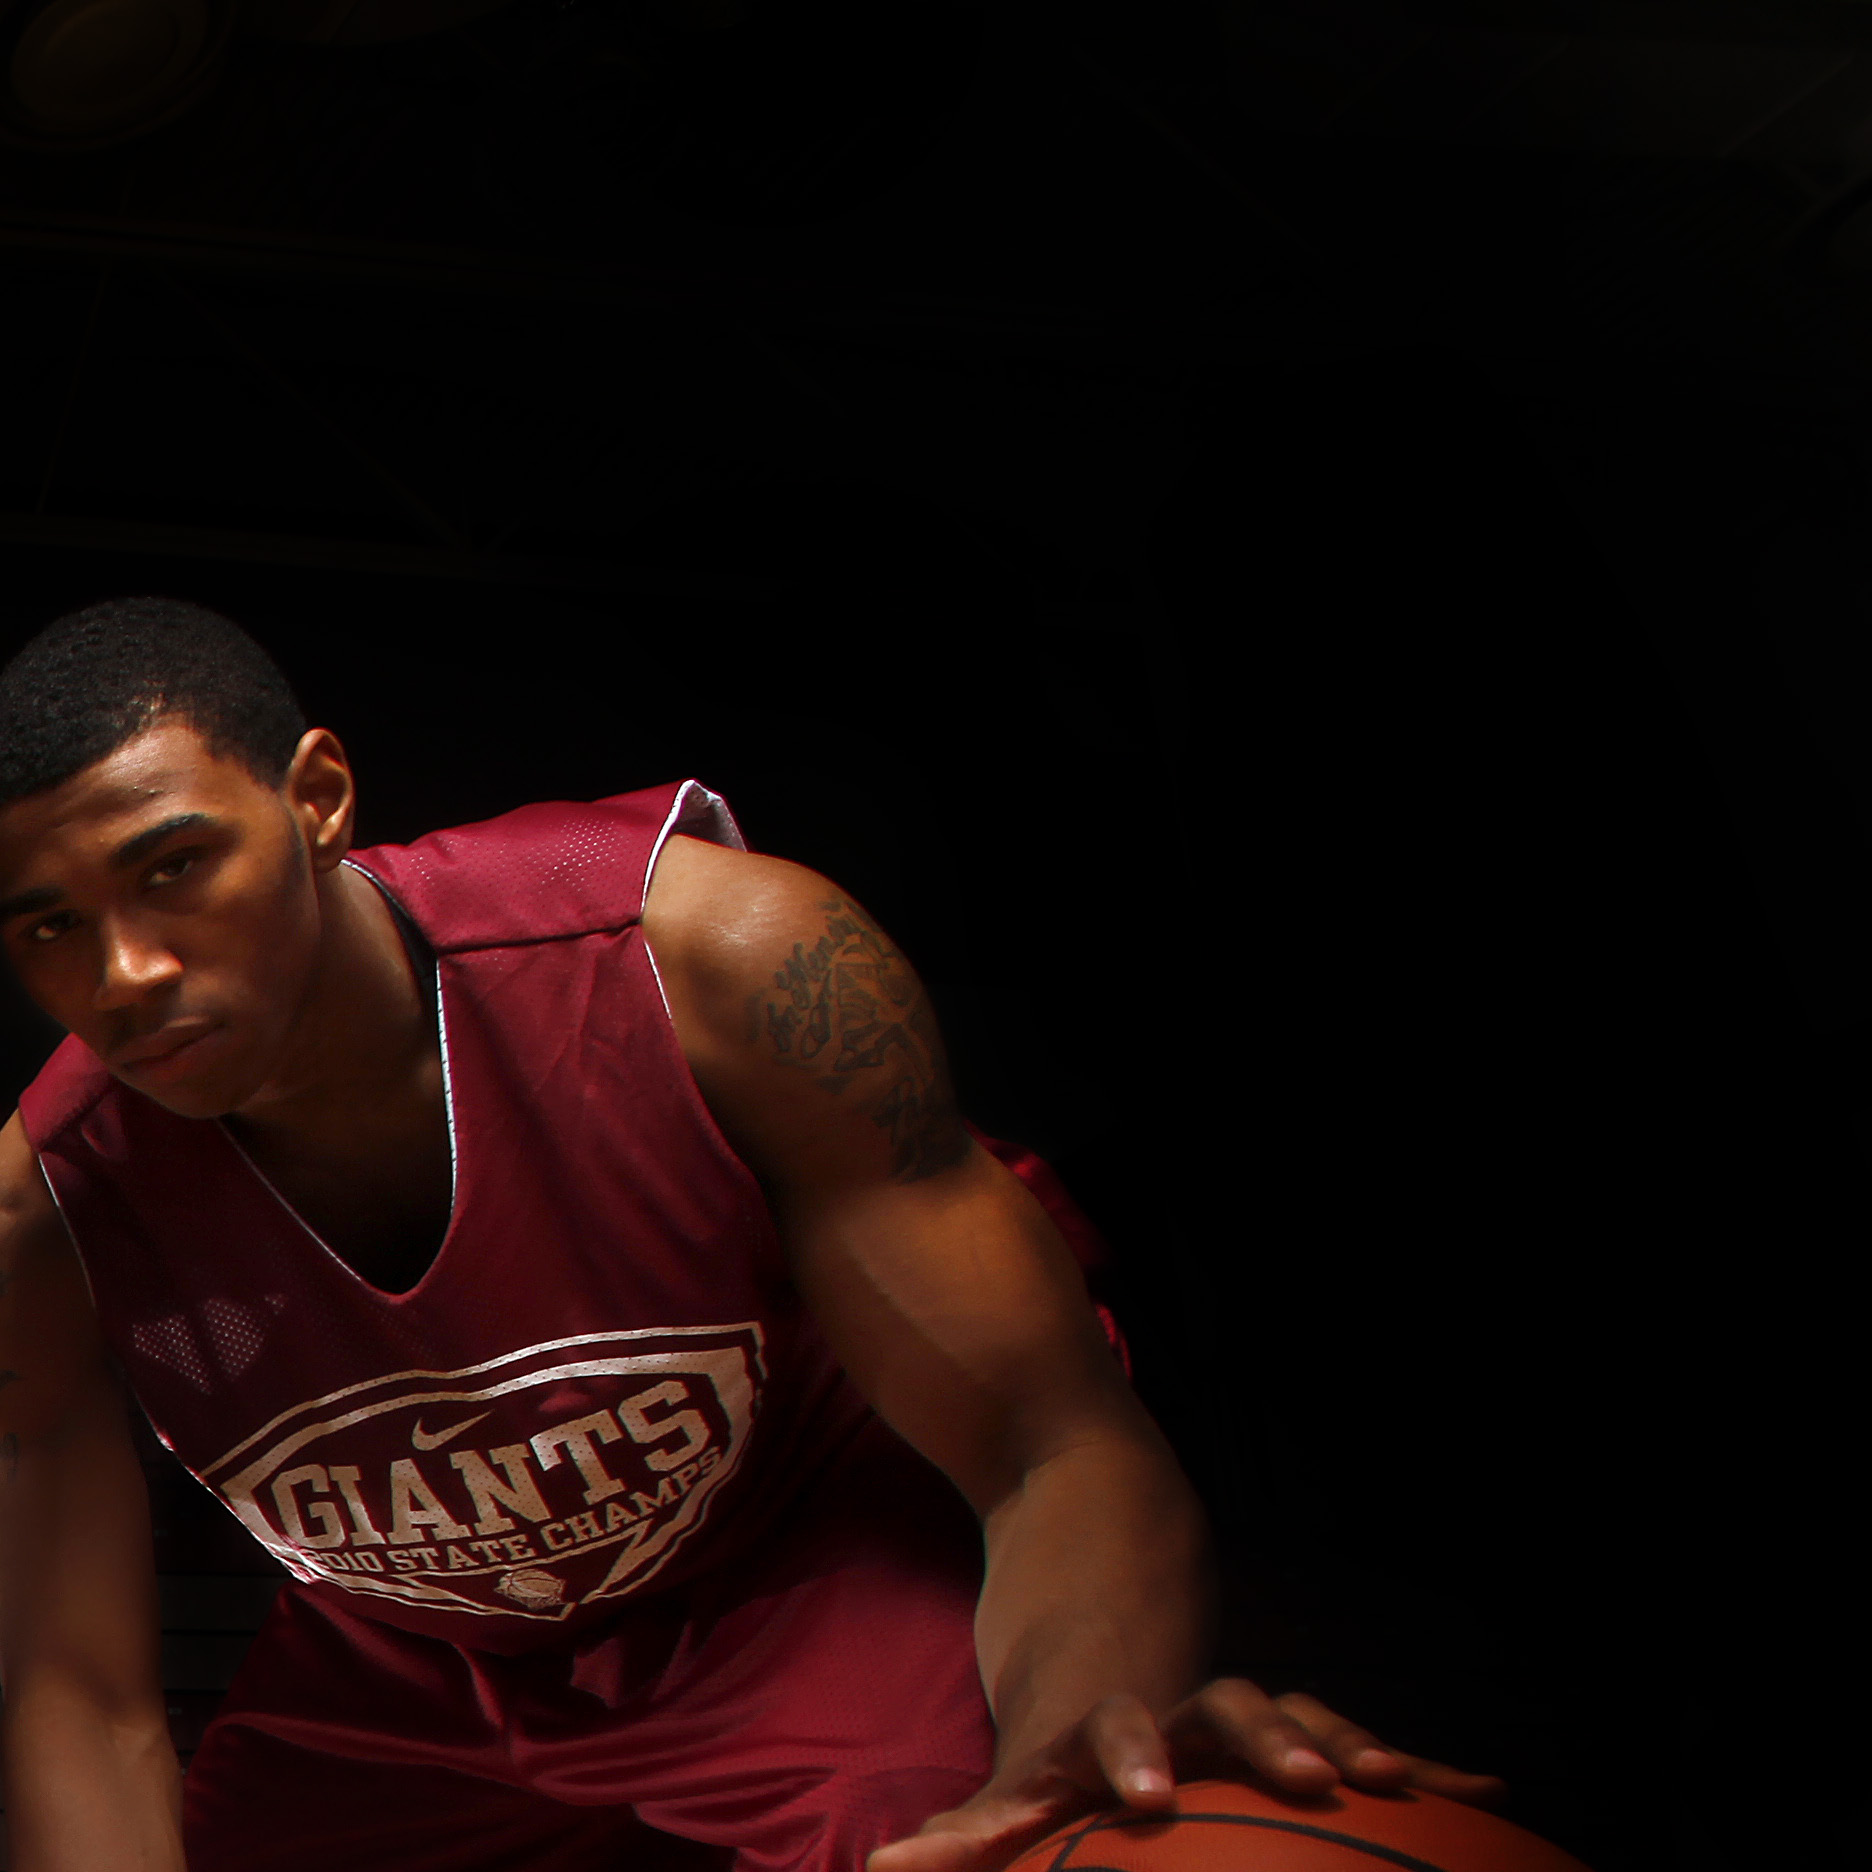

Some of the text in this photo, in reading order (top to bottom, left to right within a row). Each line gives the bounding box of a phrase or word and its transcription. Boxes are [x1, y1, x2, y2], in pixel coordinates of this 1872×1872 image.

[270, 1379, 712, 1551] GIANTS
[308, 1445, 725, 1575] 2010 STATE CHAMPS
